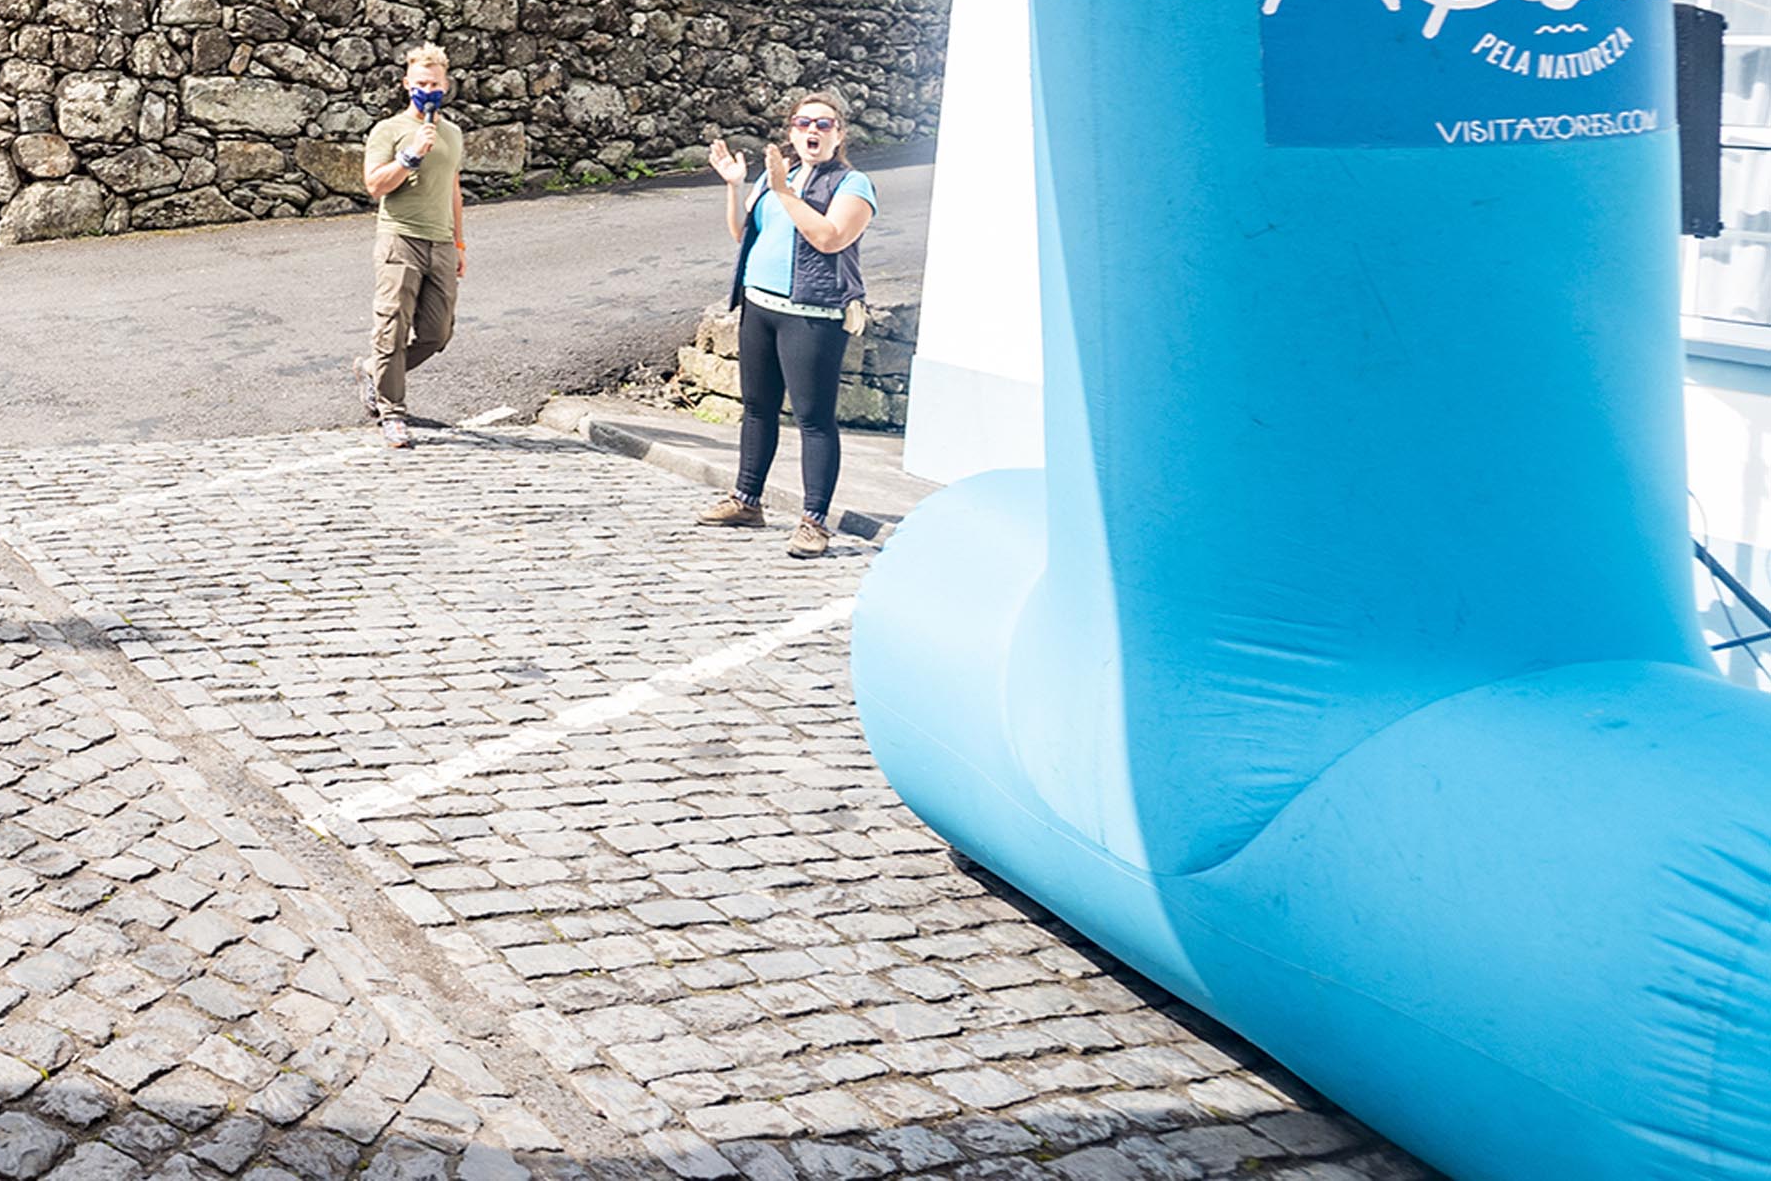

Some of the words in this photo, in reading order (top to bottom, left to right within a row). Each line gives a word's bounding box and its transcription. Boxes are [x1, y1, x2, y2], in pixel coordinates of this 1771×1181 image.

[1471, 32, 1531, 76] PELA
[1536, 26, 1634, 79] NATUREZA
[1435, 109, 1659, 143] VISITAZORES.COM
